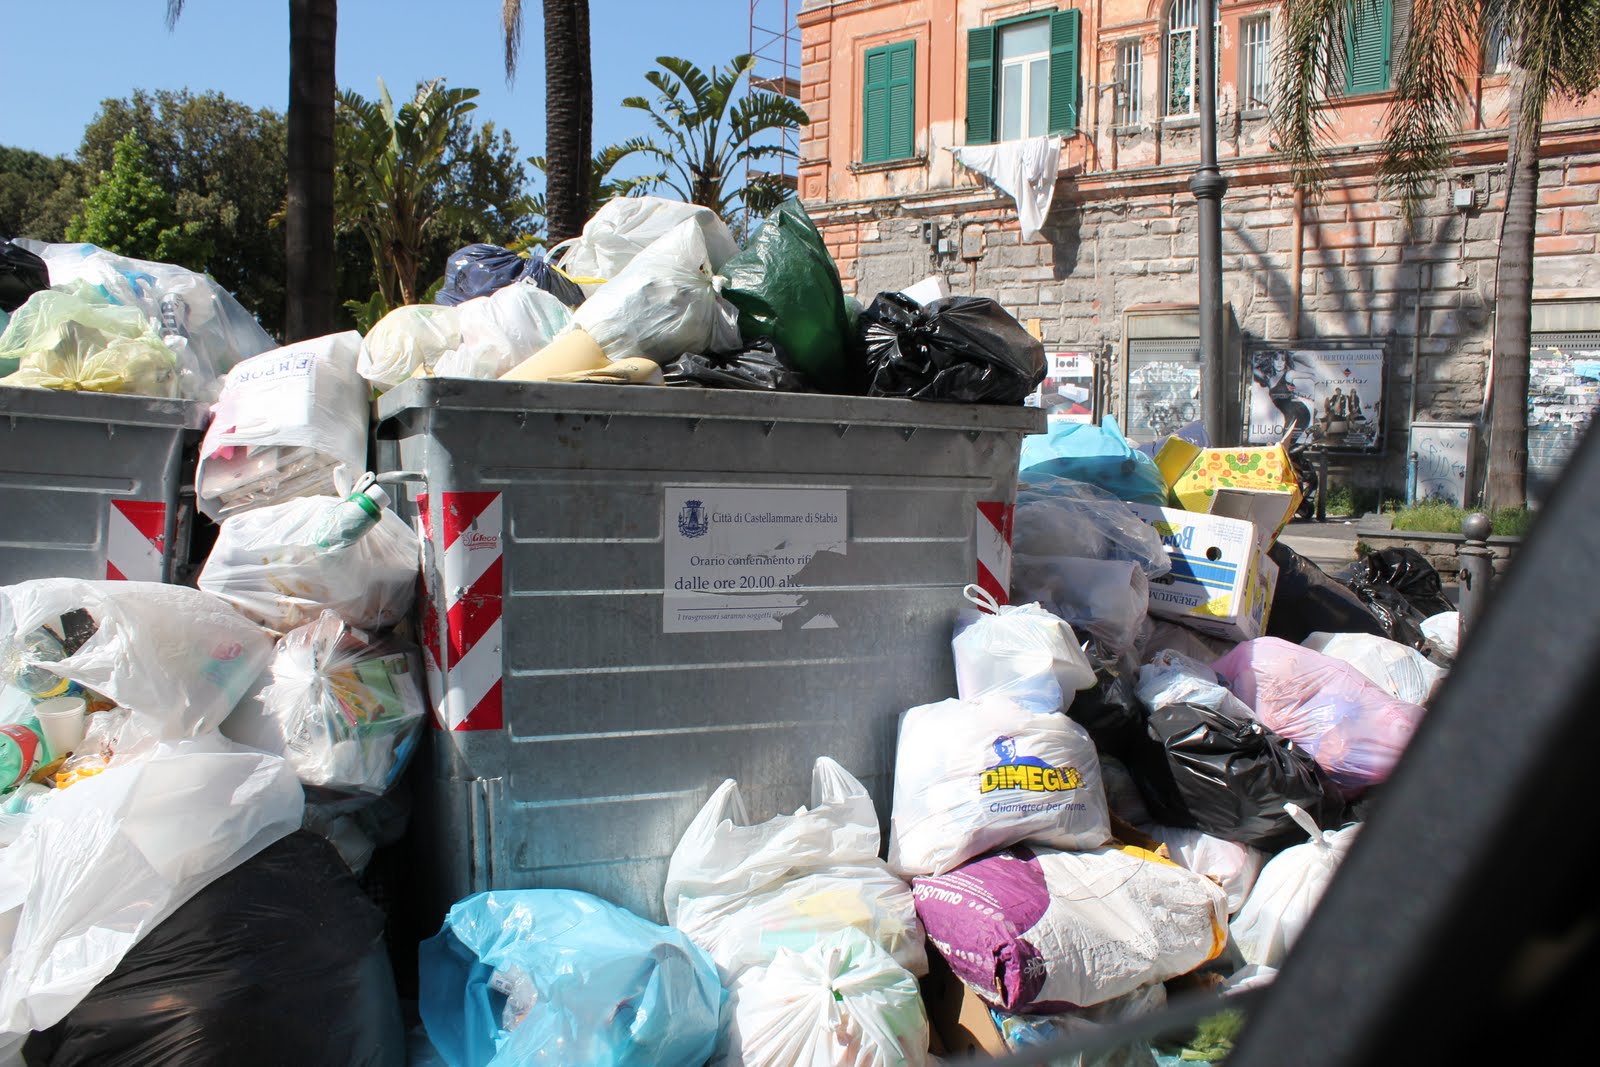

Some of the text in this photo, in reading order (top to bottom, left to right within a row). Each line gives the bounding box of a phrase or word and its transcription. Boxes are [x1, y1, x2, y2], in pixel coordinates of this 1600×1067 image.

[238, 359, 309, 383] EMPOR
[712, 512, 838, 523] Città di Castellammare di Stabia
[690, 555, 725, 566] Orario
[727, 554, 795, 566] conferimento
[674, 576, 710, 590] dalle
[713, 579, 736, 589] ore
[739, 576, 775, 589] 20.00
[1149, 590, 1198, 607] PREMIUM
[682, 612, 720, 622] trasgressori
[747, 611, 772, 621] soggetti
[989, 802, 1044, 813] Chiamateci
[1046, 803, 1061, 814] per
